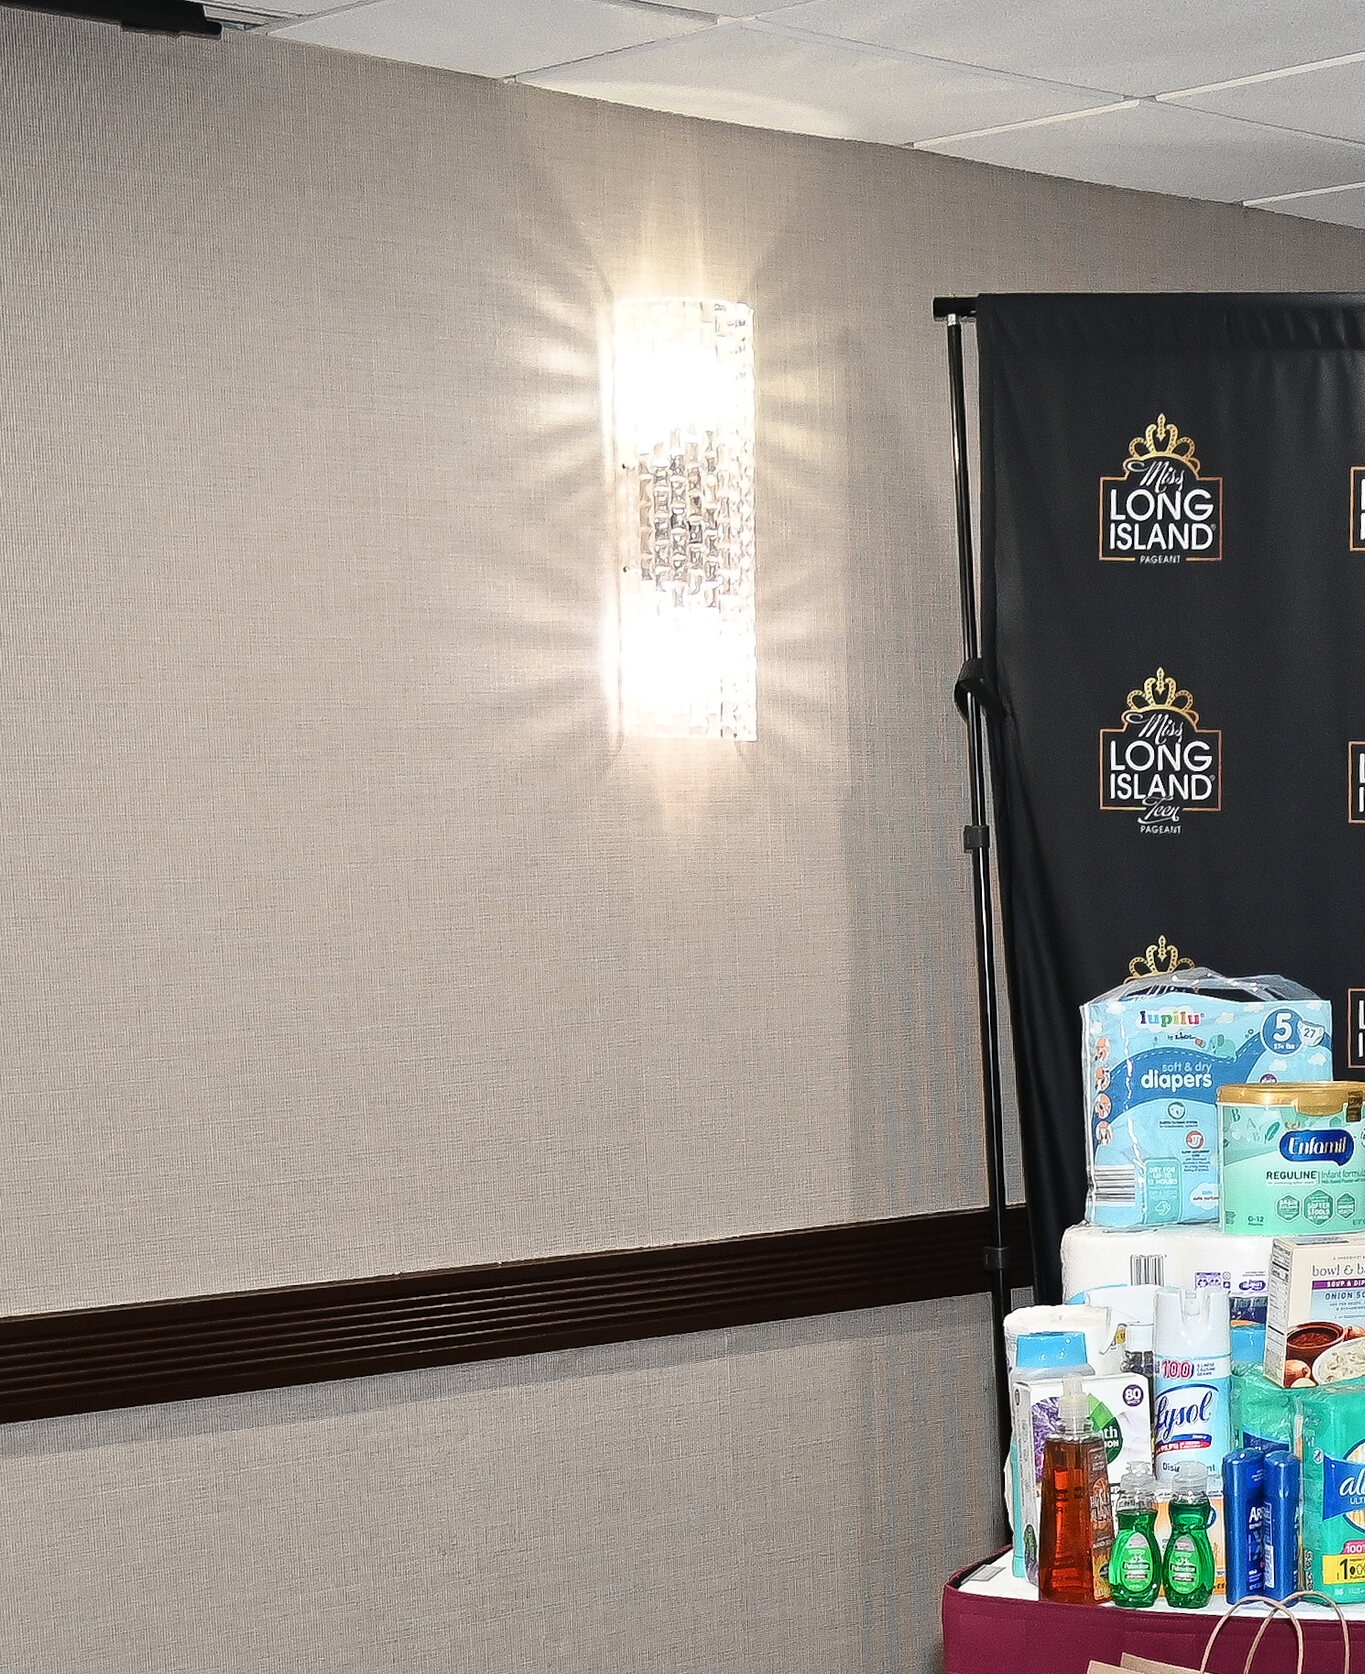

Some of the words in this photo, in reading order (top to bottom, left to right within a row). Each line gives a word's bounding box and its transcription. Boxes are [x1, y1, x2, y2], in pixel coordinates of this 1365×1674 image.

[1127, 459, 1184, 492] Miss
[1110, 490, 1214, 520] LONG
[1140, 554, 1181, 564] PAGEANT
[1127, 713, 1184, 745] Miss
[1110, 742, 1212, 772] LONG
[1140, 824, 1181, 834] PAGEANT
[1140, 1011, 1202, 1027] lupilu
[1273, 1012, 1292, 1042] 5
[1304, 1029, 1316, 1038] 27
[1162, 1062, 1182, 1071] soft
[1184, 1063, 1193, 1071] &
[1195, 1063, 1212, 1074] dry
[1141, 1070, 1212, 1092] diapers
[1289, 1137, 1347, 1154] Enfamil
[1266, 1171, 1317, 1179] REGULINE
[1313, 1263, 1340, 1276] bowl
[1344, 1265, 1354, 1275] &
[1325, 1292, 1353, 1300] ONION
